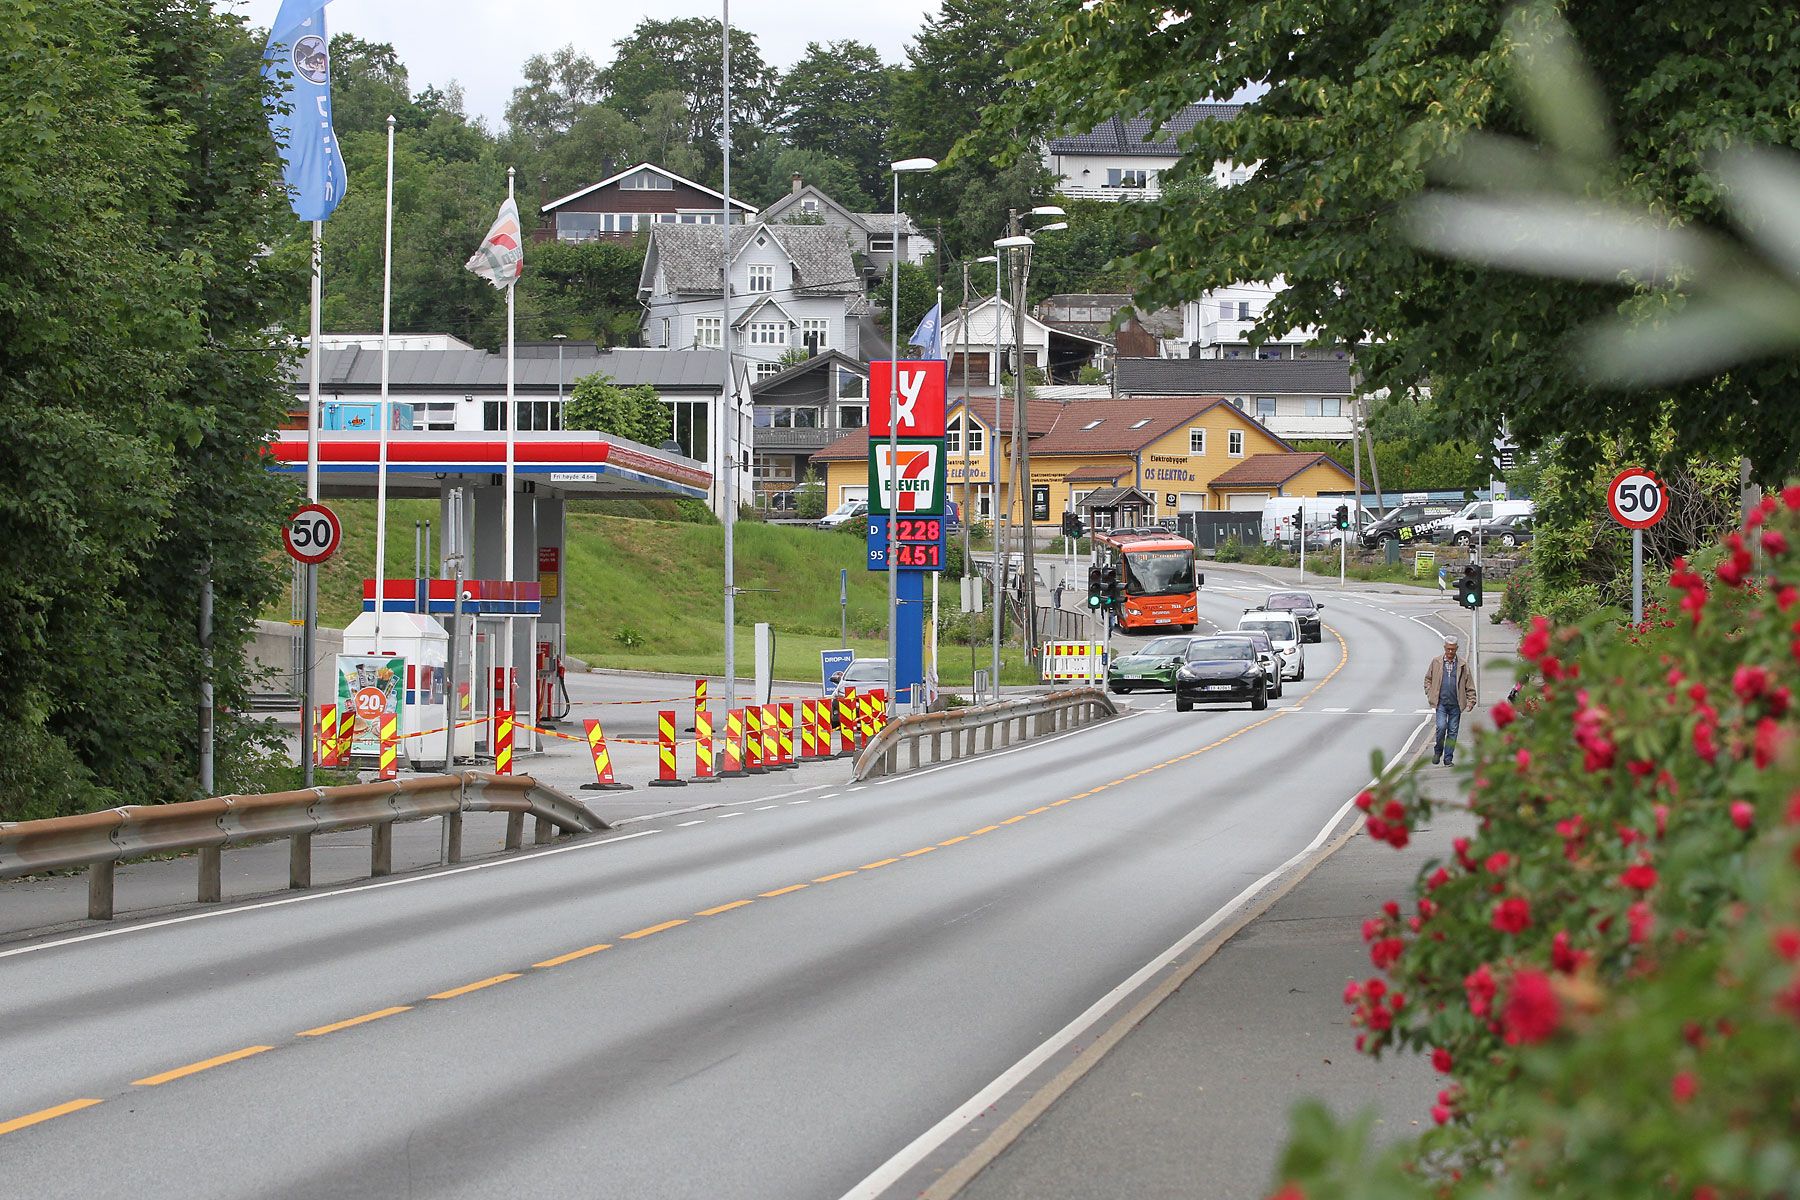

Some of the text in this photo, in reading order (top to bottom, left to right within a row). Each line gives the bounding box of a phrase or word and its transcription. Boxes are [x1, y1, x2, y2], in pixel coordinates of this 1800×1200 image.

[1150, 455, 1188, 464] Elektrobygget
[1144, 468, 1155, 480] OS
[1157, 468, 1188, 481] ELEKTRO
[1619, 483, 1659, 513] 50
[293, 519, 331, 548] 50
[870, 525, 879, 535] D
[870, 550, 884, 560] 95
